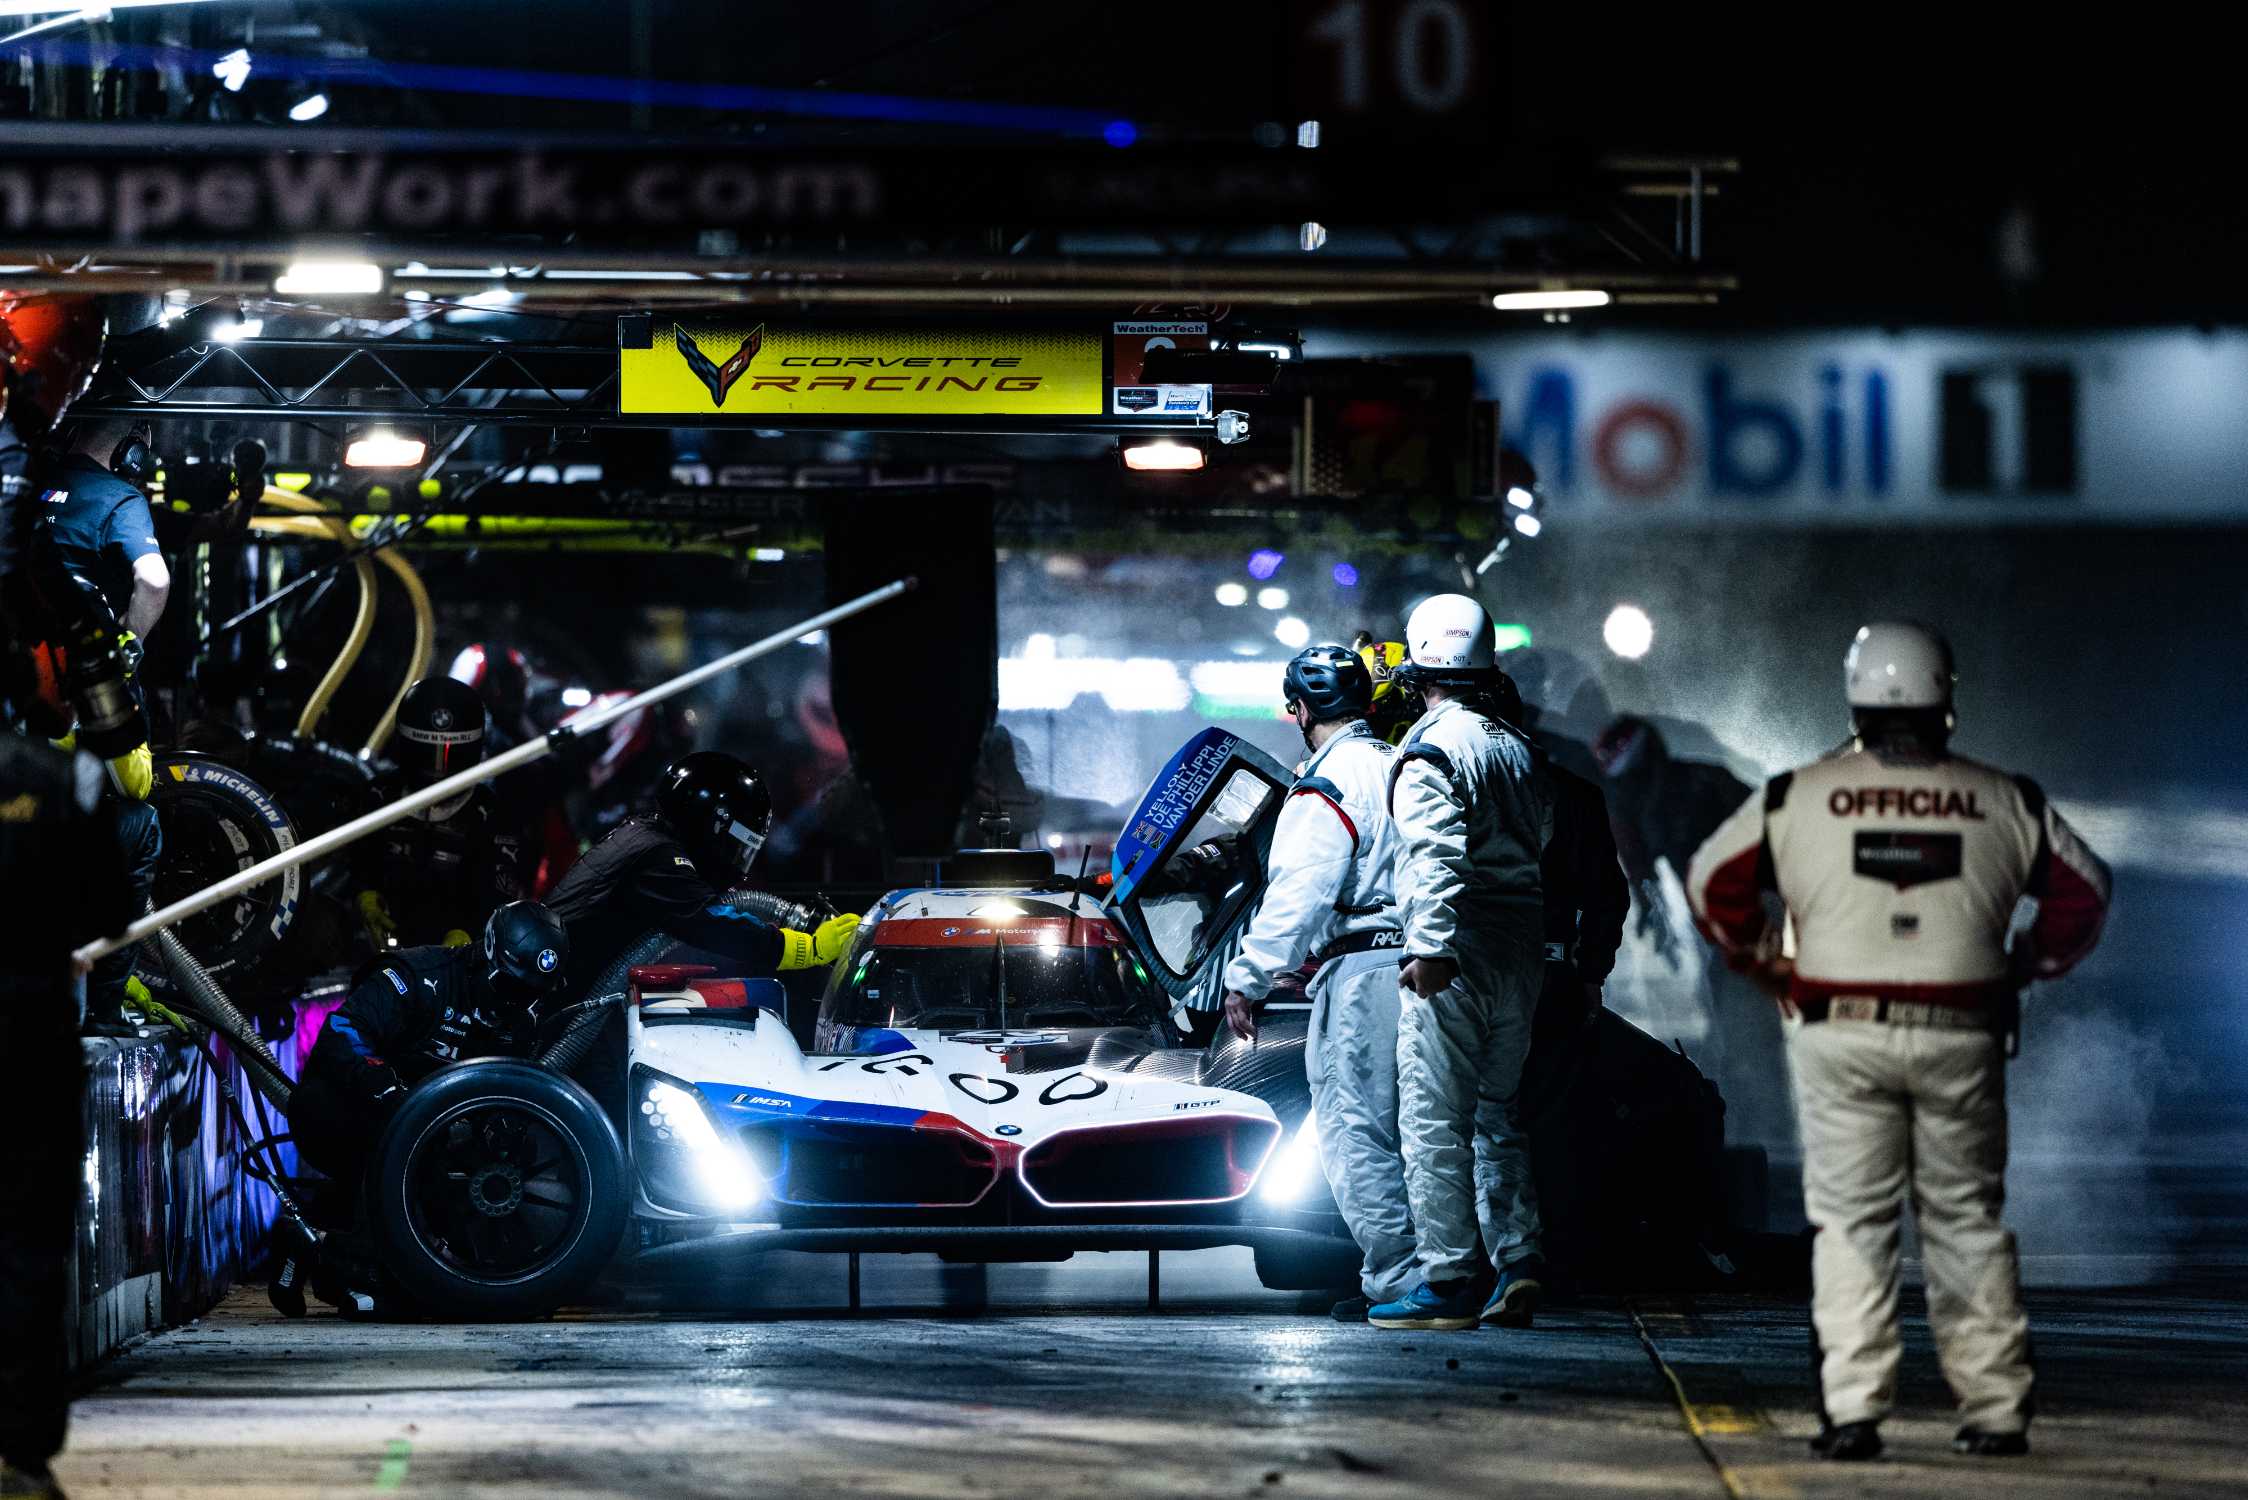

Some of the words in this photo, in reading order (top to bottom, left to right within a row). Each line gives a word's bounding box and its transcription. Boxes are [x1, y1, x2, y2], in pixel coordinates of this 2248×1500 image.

[1307, 0, 1473, 110] 10
[1116, 324, 1204, 333] WeatherTech
[781, 356, 1023, 368] CORVETTE
[751, 375, 1043, 392] RACING
[1476, 362, 1892, 498] Mobil
[203, 769, 281, 823] MICHELIN
[1145, 763, 1187, 818] YELLOLY
[1153, 804, 1172, 825] DE
[1167, 744, 1215, 805] PHILLIPPI
[1163, 804, 1188, 830] VAN
[1184, 774, 1209, 806] DER
[1205, 735, 1237, 774] LINDE
[1829, 788, 1986, 821] OFFICIAL
[1370, 931, 1404, 947] RAC
[749, 1096, 792, 1108] IMSA
[1190, 1099, 1221, 1108] GTP
